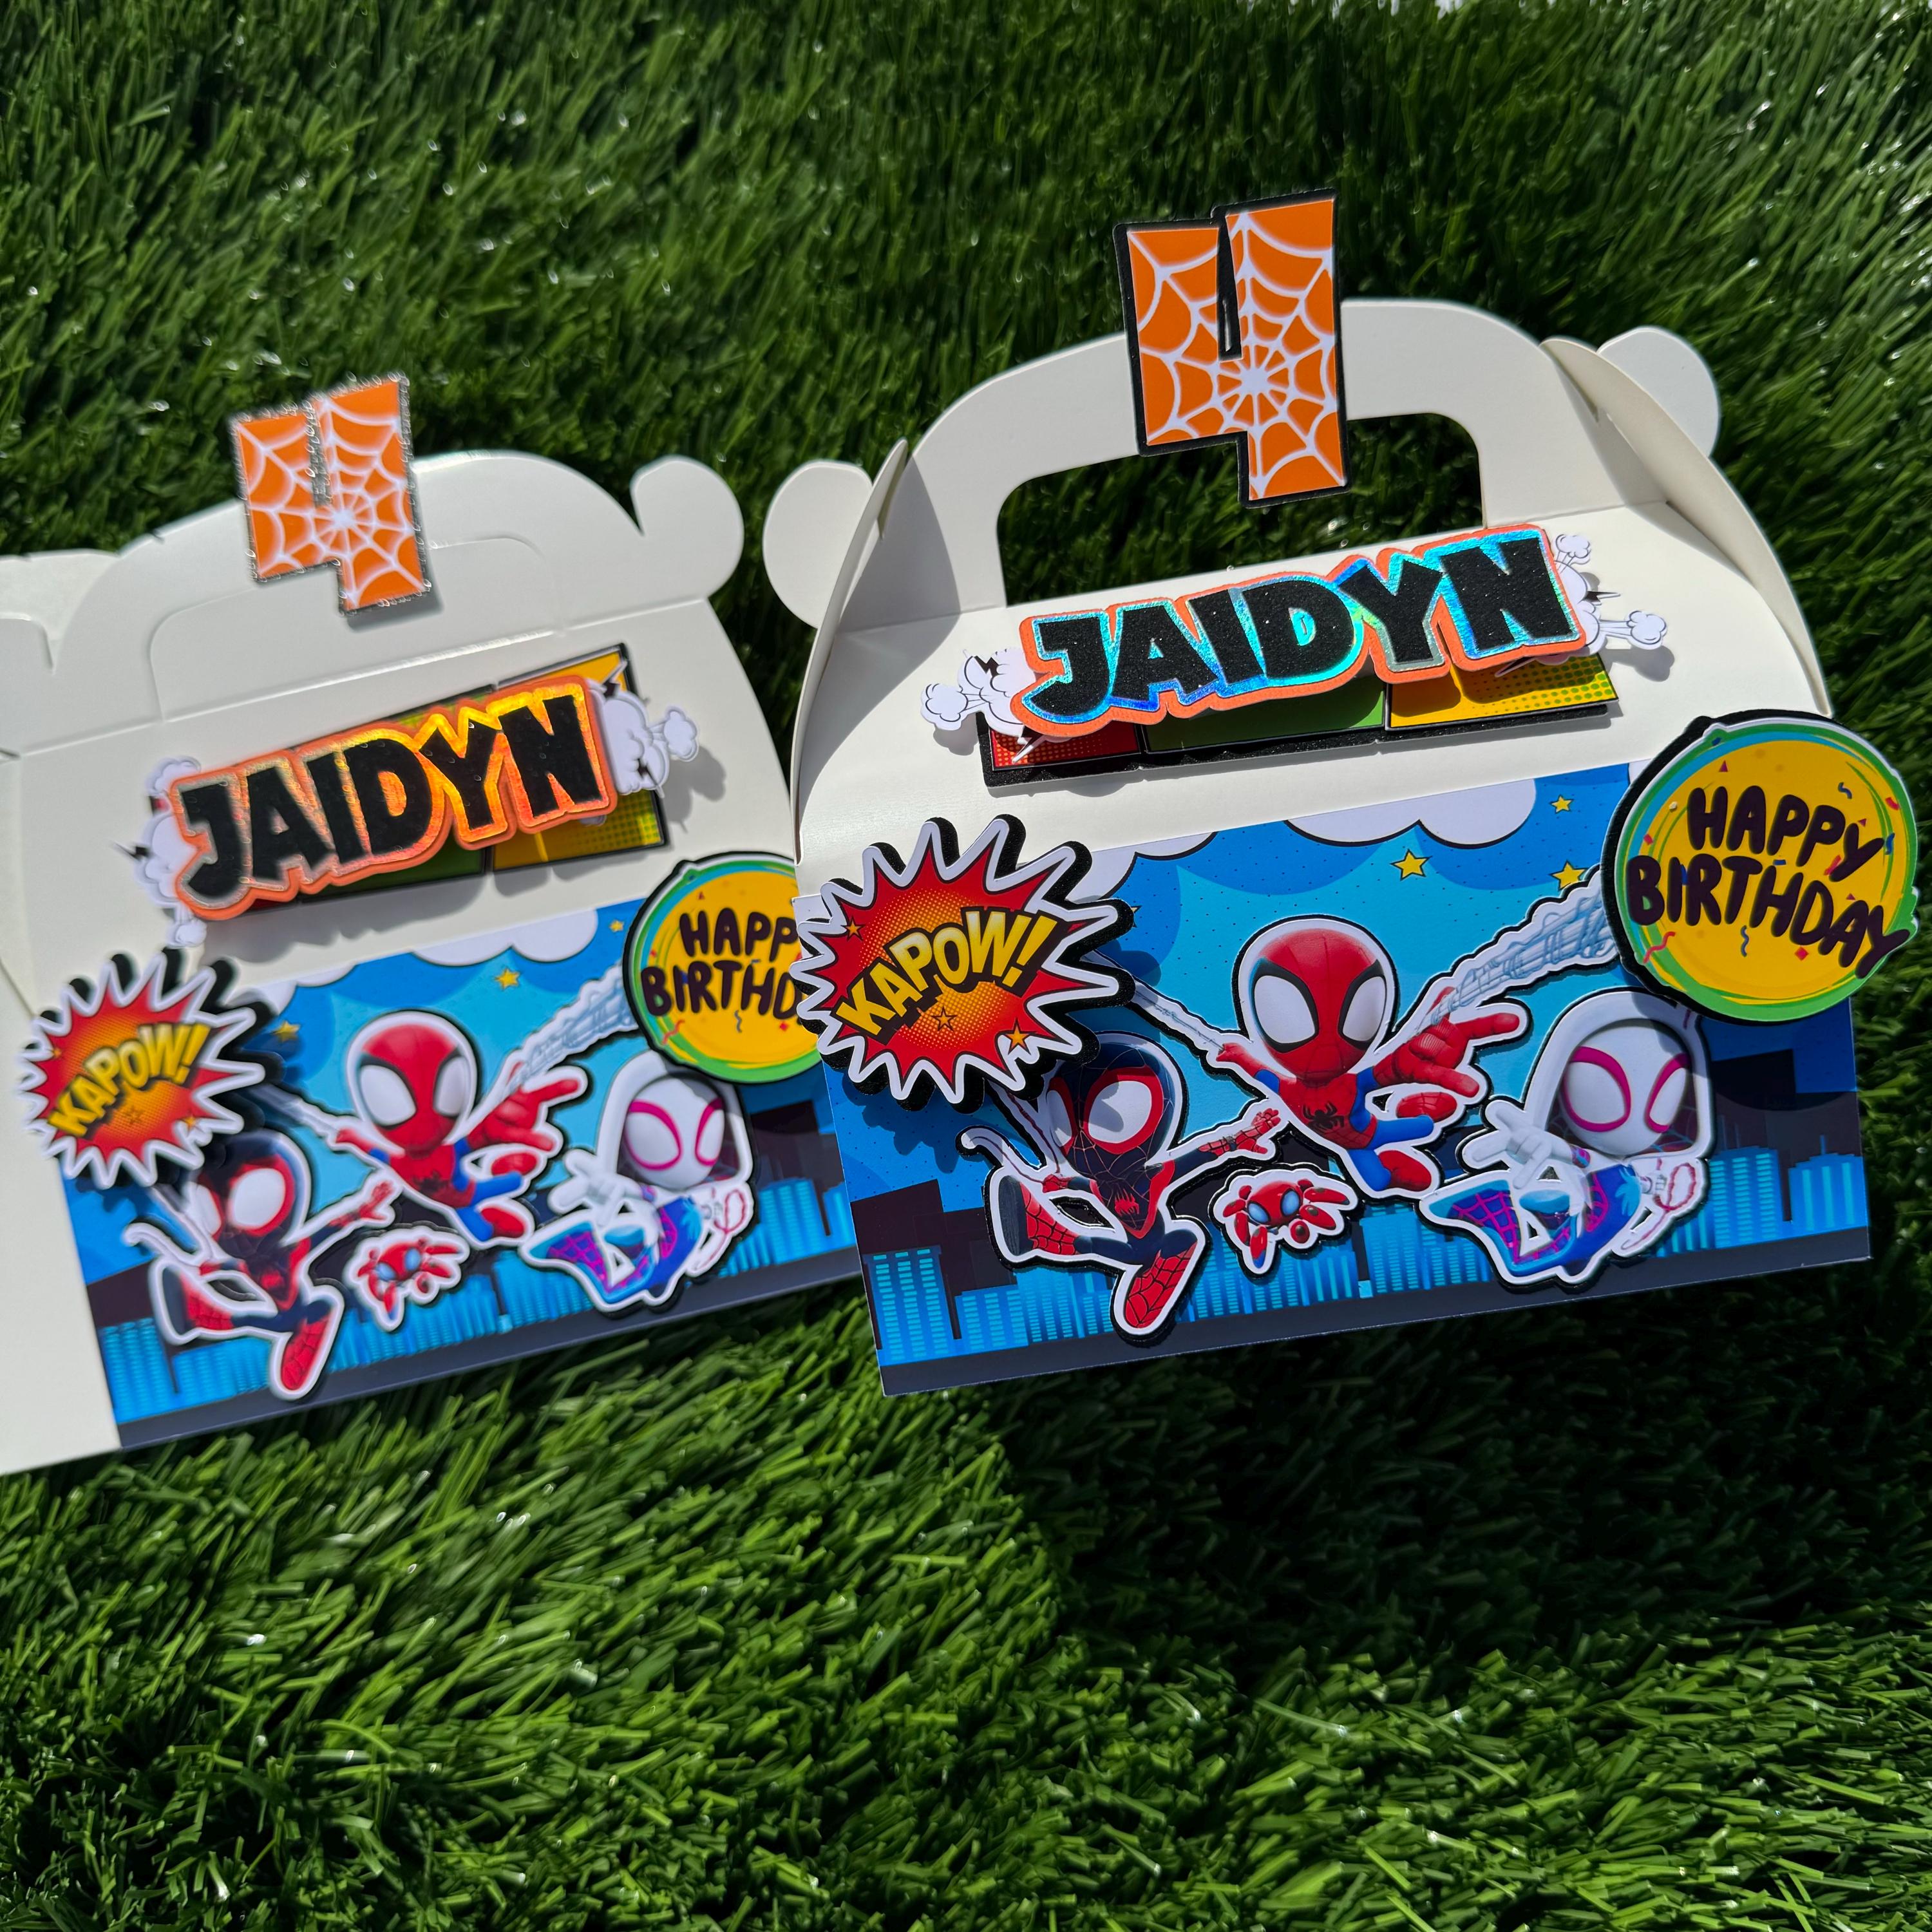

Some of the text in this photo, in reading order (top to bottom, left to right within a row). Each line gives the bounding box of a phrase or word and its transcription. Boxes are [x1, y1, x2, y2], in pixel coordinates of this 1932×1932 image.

[1127, 198, 1346, 501] 4
[237, 380, 425, 612] 4
[1030, 536, 1575, 718] JAIDYN
[180, 694, 600, 898] JAIDYN
[1687, 785, 1885, 882] HAPPY
[679, 907, 799, 963] HAPP
[835, 910, 1058, 1036] KAPOW!
[1625, 853, 1910, 979] BIRTHDAY
[640, 960, 803, 1023] BIRTHD
[48, 1023, 211, 1137] KAPOW!
